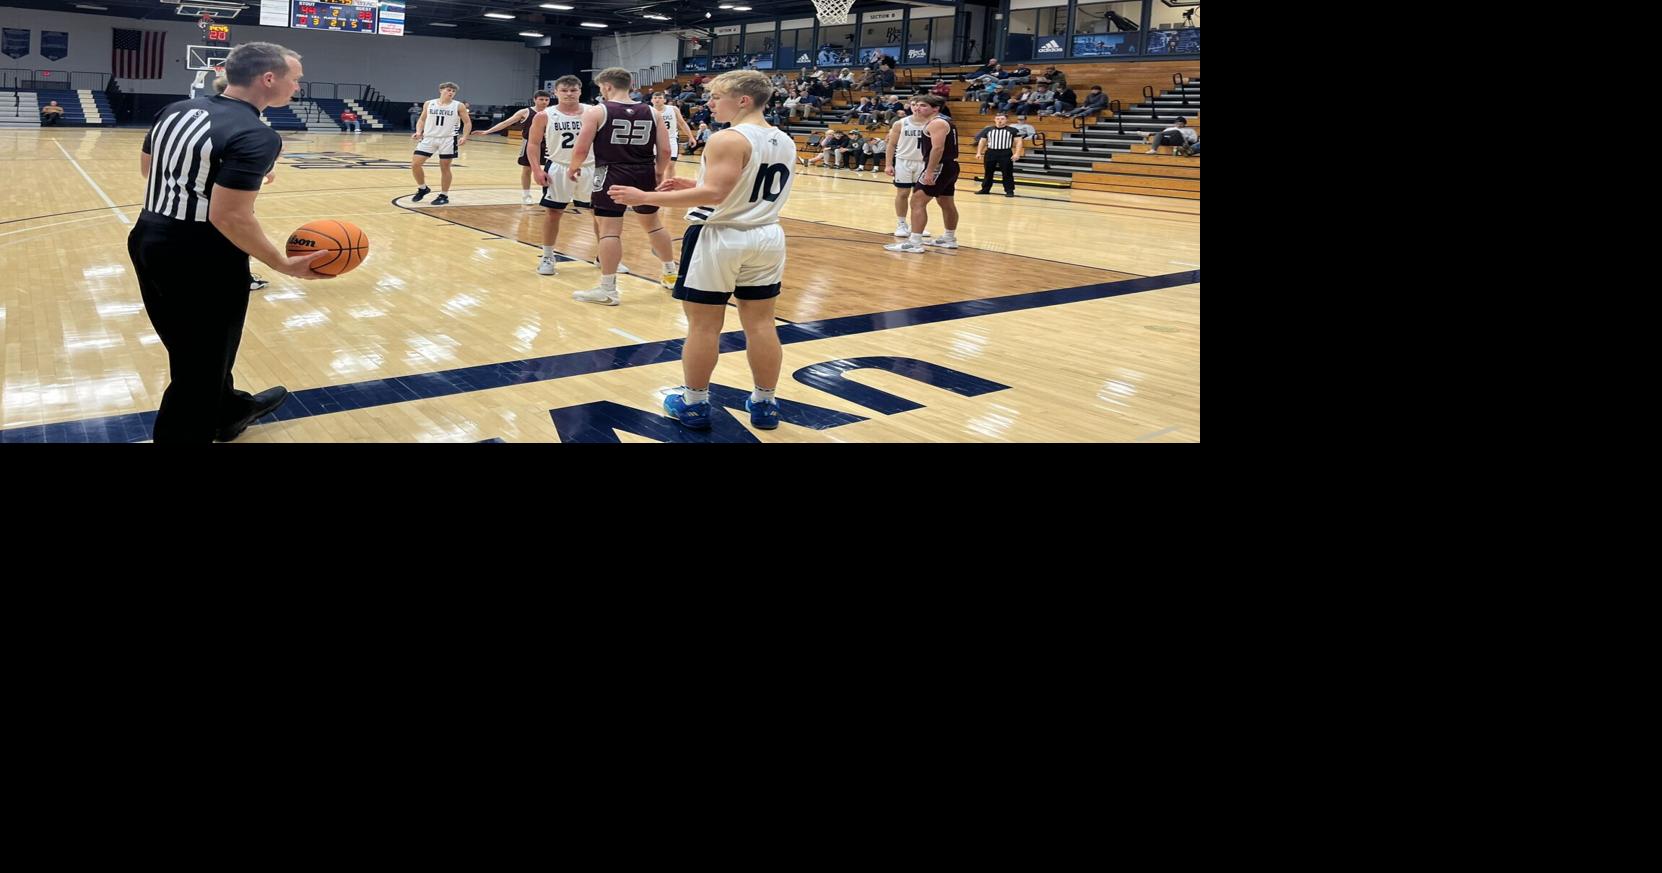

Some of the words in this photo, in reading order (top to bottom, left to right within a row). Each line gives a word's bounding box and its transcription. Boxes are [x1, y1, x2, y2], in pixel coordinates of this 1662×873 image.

[209, 31, 226, 40] 20
[435, 115, 445, 126] 11
[554, 121, 571, 131] BLUE
[610, 118, 653, 146] 23
[904, 129, 917, 137] BLUE
[748, 162, 790, 203] 10
